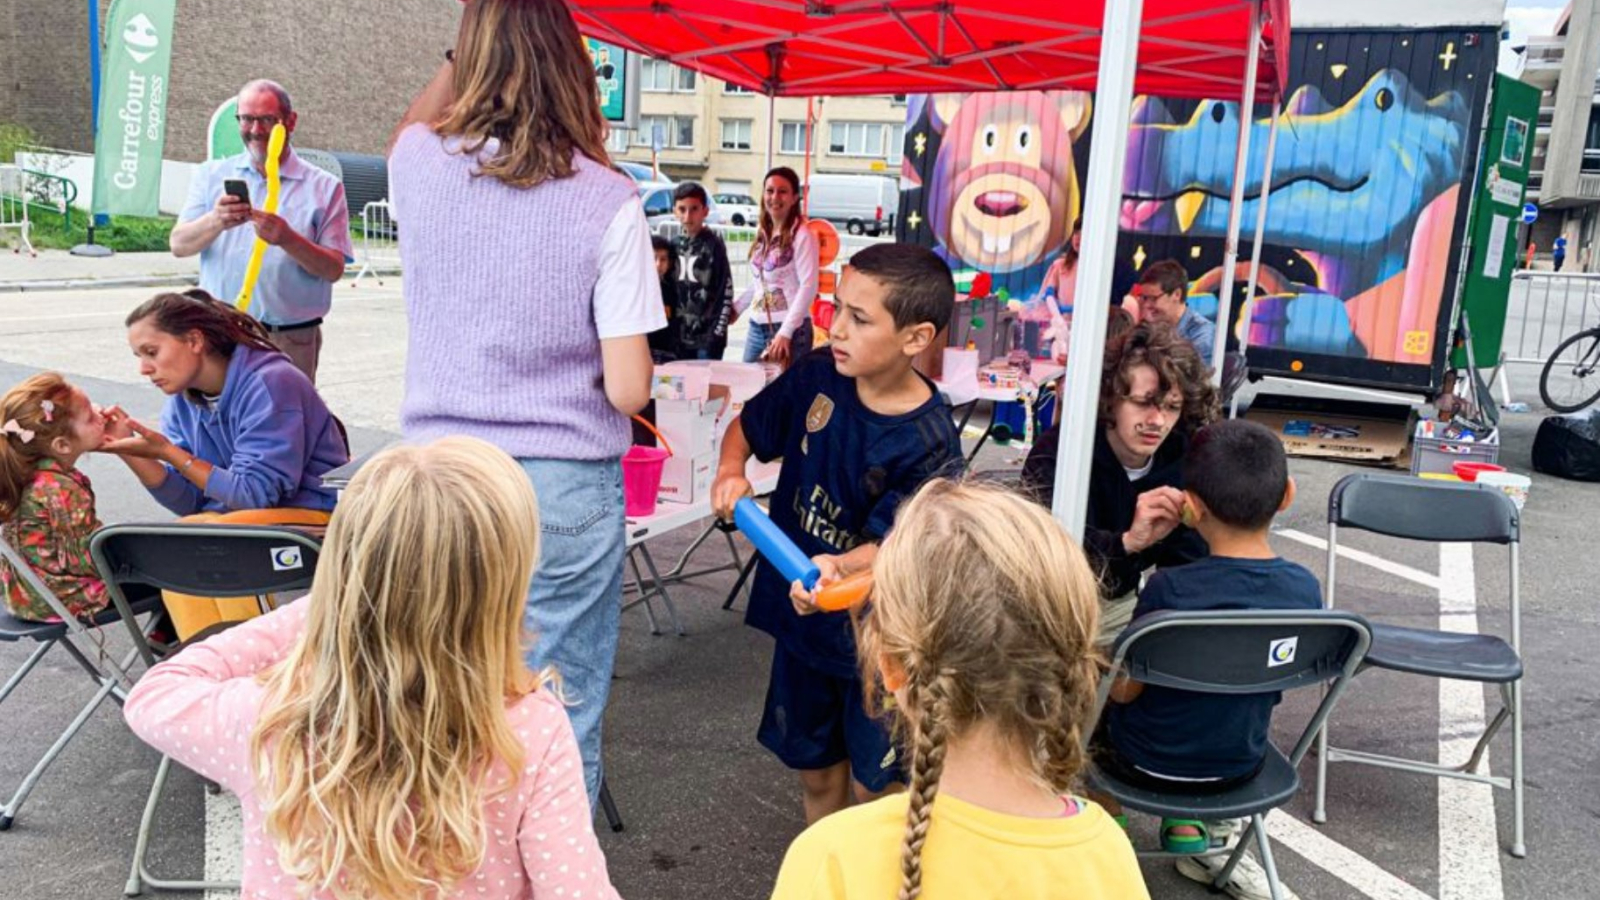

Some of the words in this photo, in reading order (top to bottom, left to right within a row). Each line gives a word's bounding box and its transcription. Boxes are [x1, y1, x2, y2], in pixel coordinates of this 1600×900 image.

[113, 69, 145, 190] Carrefour
[146, 74, 162, 141] express
[810, 483, 842, 520] Fly
